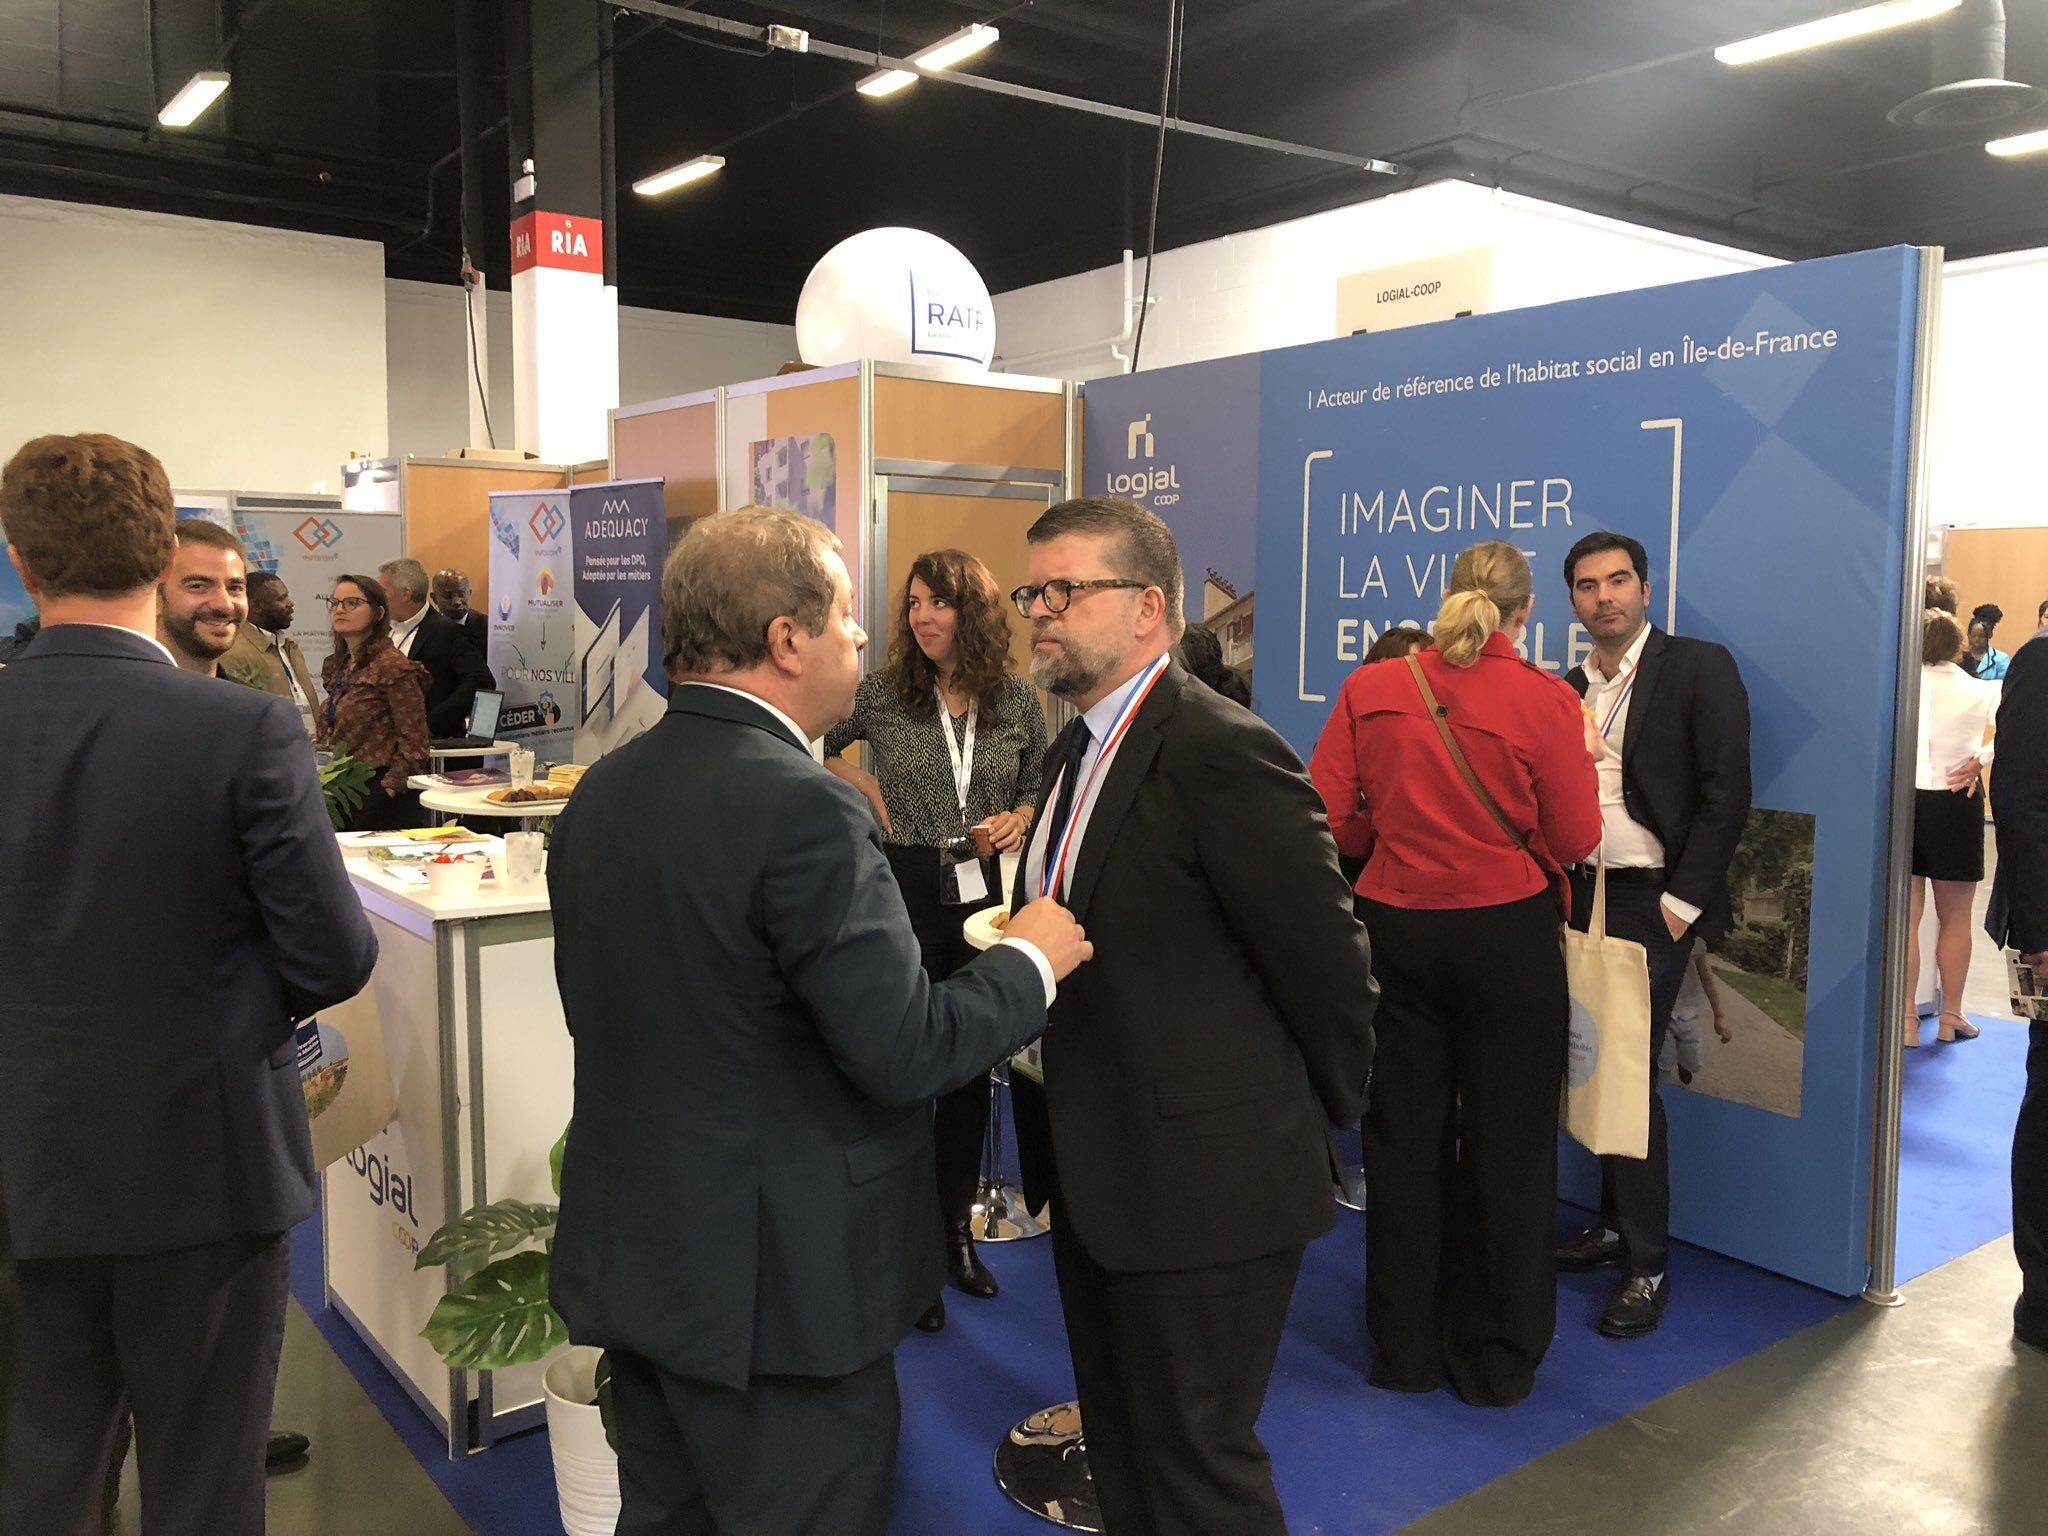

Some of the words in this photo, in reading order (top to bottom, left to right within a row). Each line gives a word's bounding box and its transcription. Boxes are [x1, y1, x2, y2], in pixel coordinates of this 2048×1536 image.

[516, 232, 531, 258] RIA
[551, 229, 588, 257] RIA
[1376, 281, 1442, 304] LOGIAL-COOP
[1317, 389, 1368, 408] Acteur
[1372, 381, 1391, 402] de
[1396, 375, 1474, 398] référence
[1479, 367, 1501, 388] de
[1586, 347, 1642, 376] social
[1649, 350, 1675, 368] en
[1682, 329, 1839, 364] Île-de-France
[1107, 464, 1180, 499] logial
[1154, 494, 1180, 506] COOP
[1340, 478, 1574, 535] IMAGINER
[585, 518, 649, 539] ADEQUACY
[606, 556, 620, 568] pour
[621, 554, 631, 566] les
[617, 569, 627, 580] les
[1339, 555, 1388, 599] LA
[528, 599, 564, 608] MUTUALISER
[531, 668, 553, 682] NOS
[555, 669, 576, 684] VILL
[500, 709, 536, 727] CÉDER
